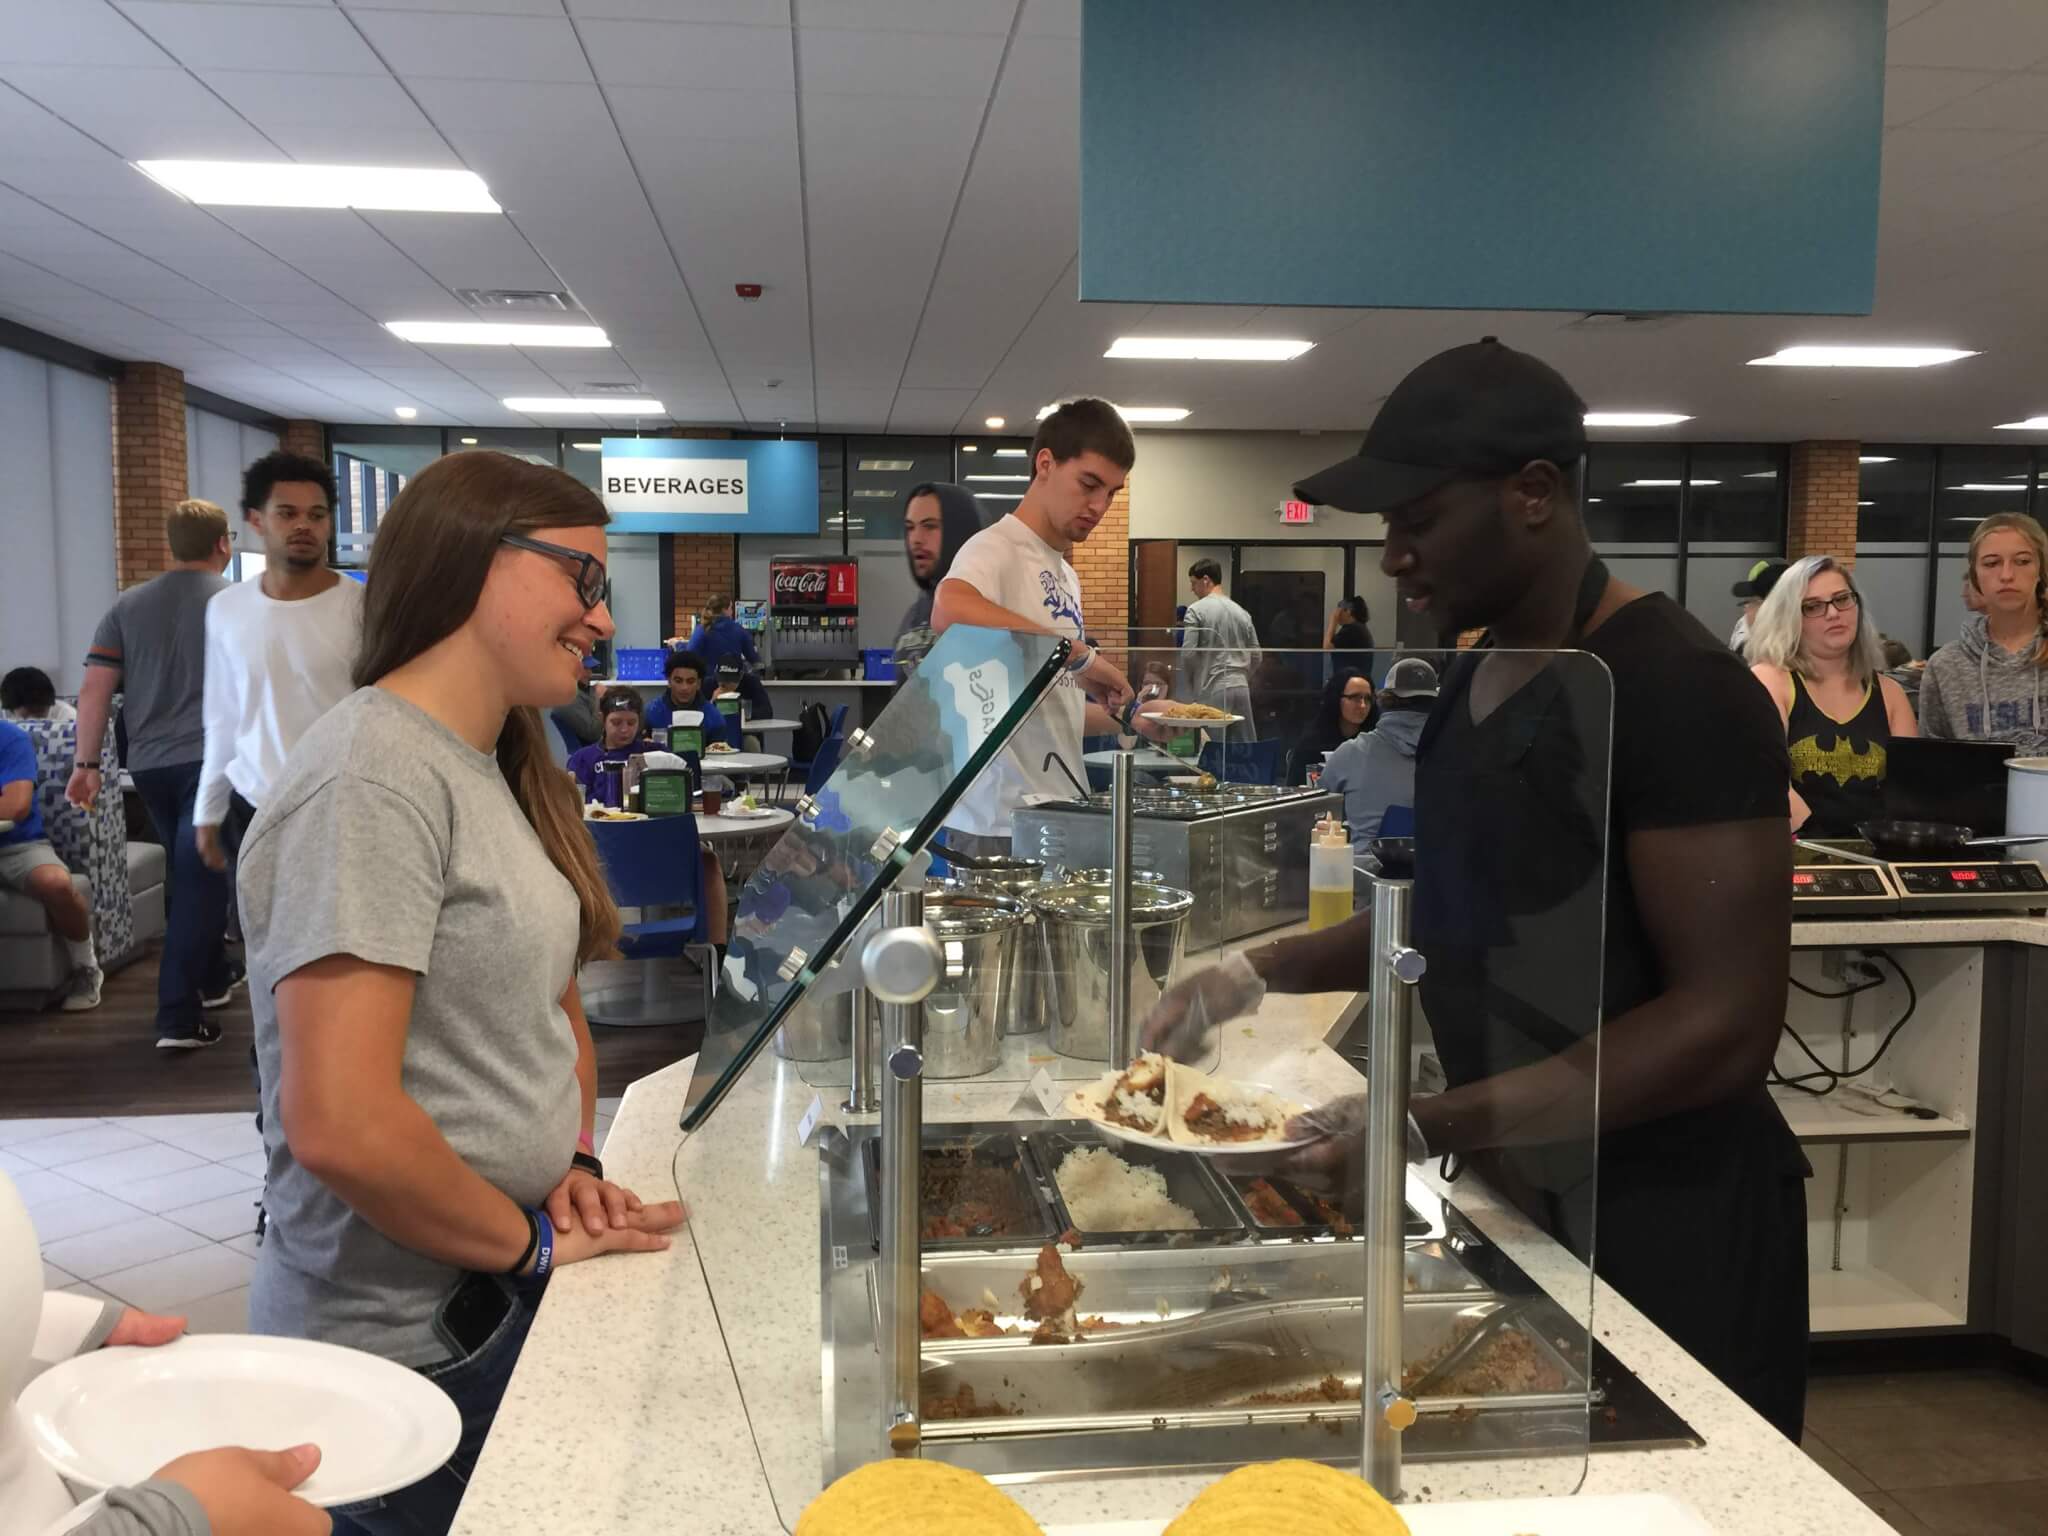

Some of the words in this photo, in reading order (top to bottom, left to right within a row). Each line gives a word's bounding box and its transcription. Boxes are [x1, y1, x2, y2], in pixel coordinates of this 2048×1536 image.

[607, 477, 744, 494] BEVERAGES
[1286, 502, 1308, 520] EXIT
[775, 571, 827, 592] Coca-Cola
[537, 1247, 551, 1273] DWU
